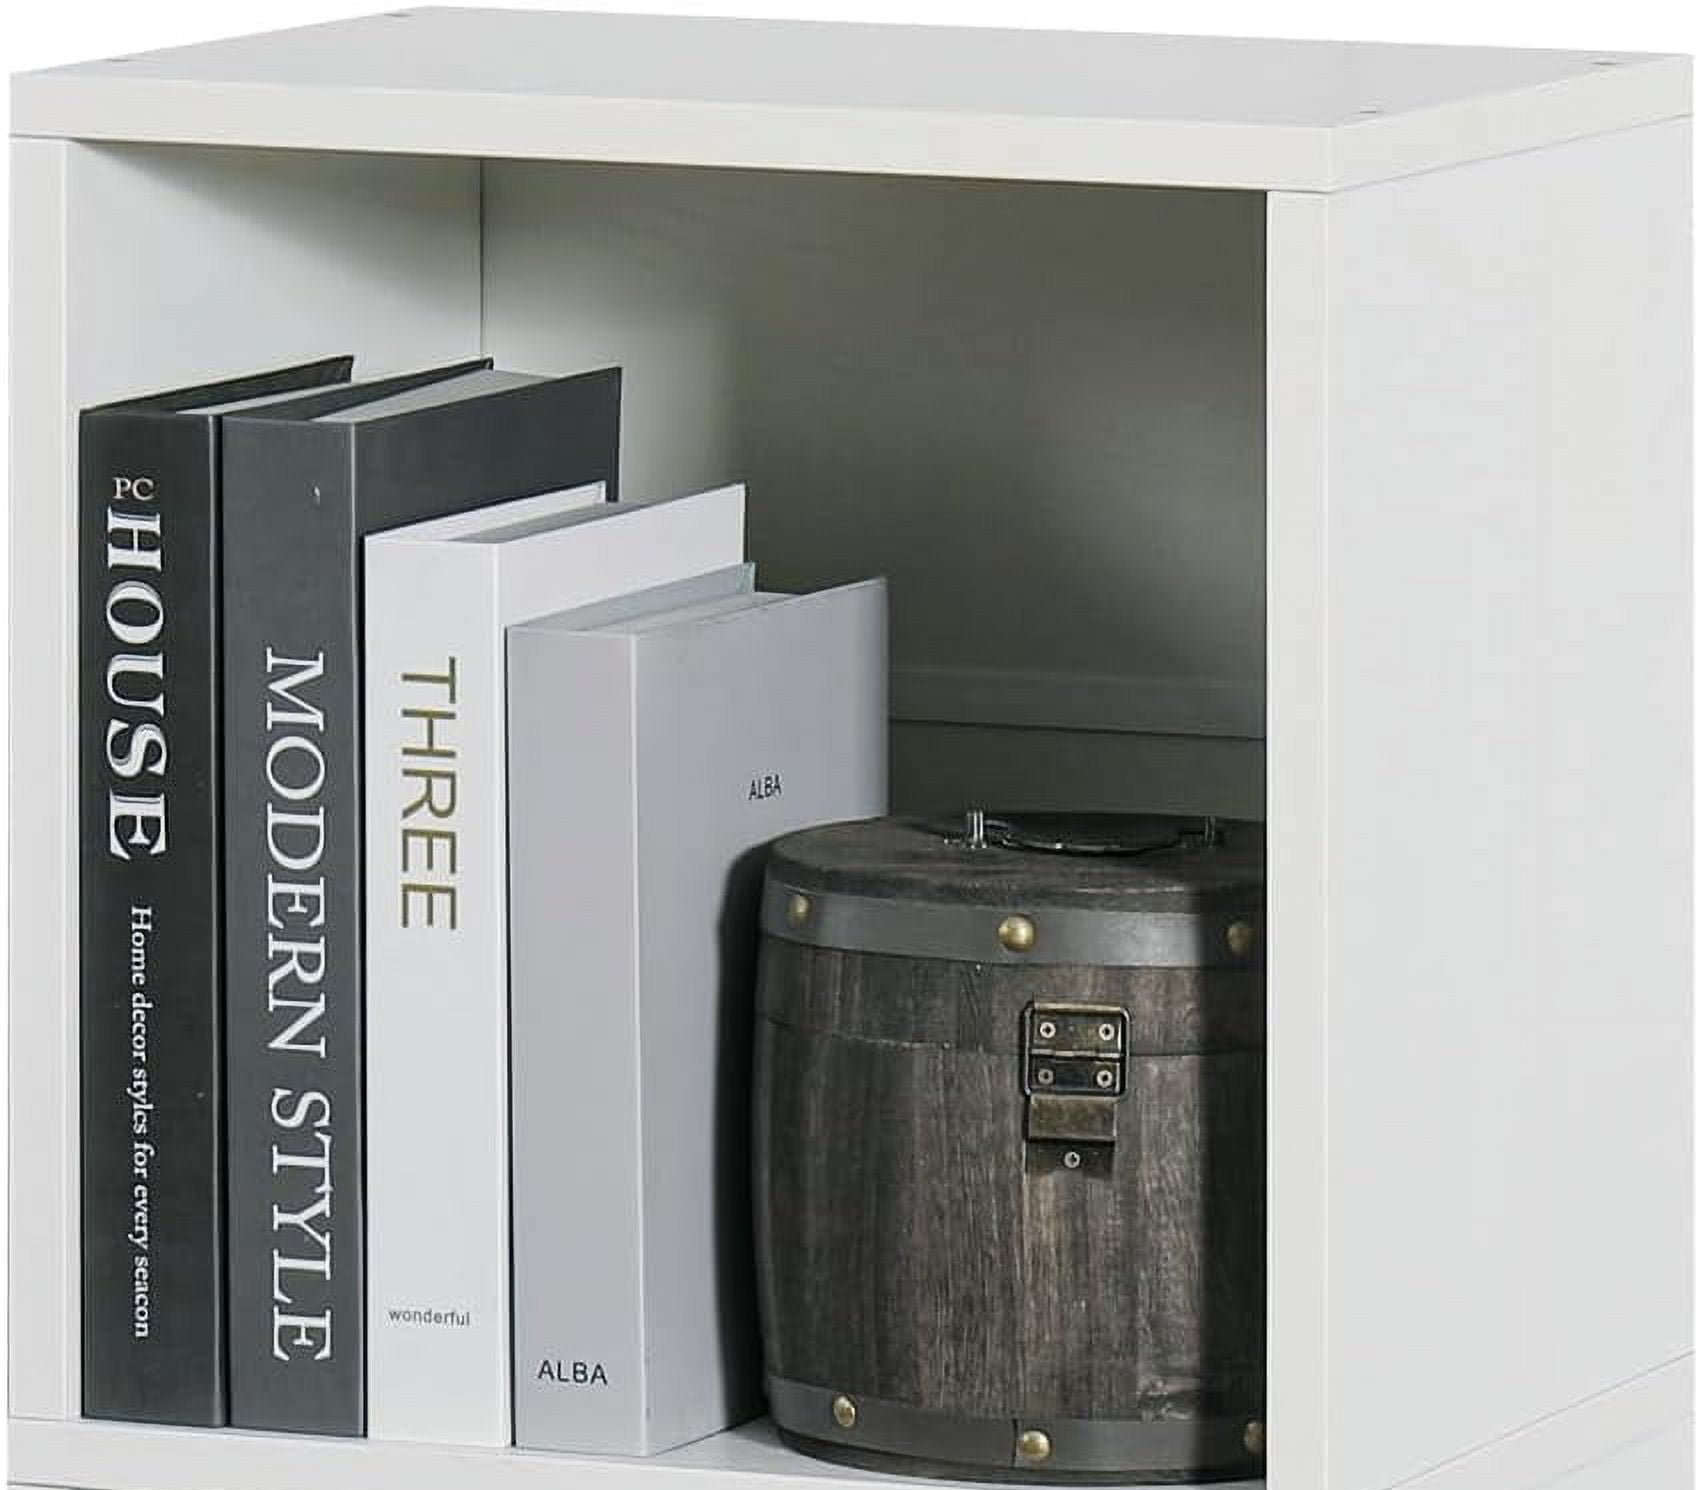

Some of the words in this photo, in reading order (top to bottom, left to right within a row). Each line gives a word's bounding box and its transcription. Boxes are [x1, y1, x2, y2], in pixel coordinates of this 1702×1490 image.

[114, 478, 153, 500] PC
[107, 507, 166, 859] HOUSE
[402, 657, 456, 930] THREE
[749, 775, 781, 800] ALBA
[266, 647, 325, 1058] MODERN
[132, 907, 151, 985] Home
[132, 993, 153, 1062] decor
[134, 1142, 154, 1178] for
[128, 1185, 148, 1250] every
[272, 1088, 332, 1360] STYLE
[389, 1309, 470, 1326] wonderful
[538, 1360, 607, 1385] ALBA
